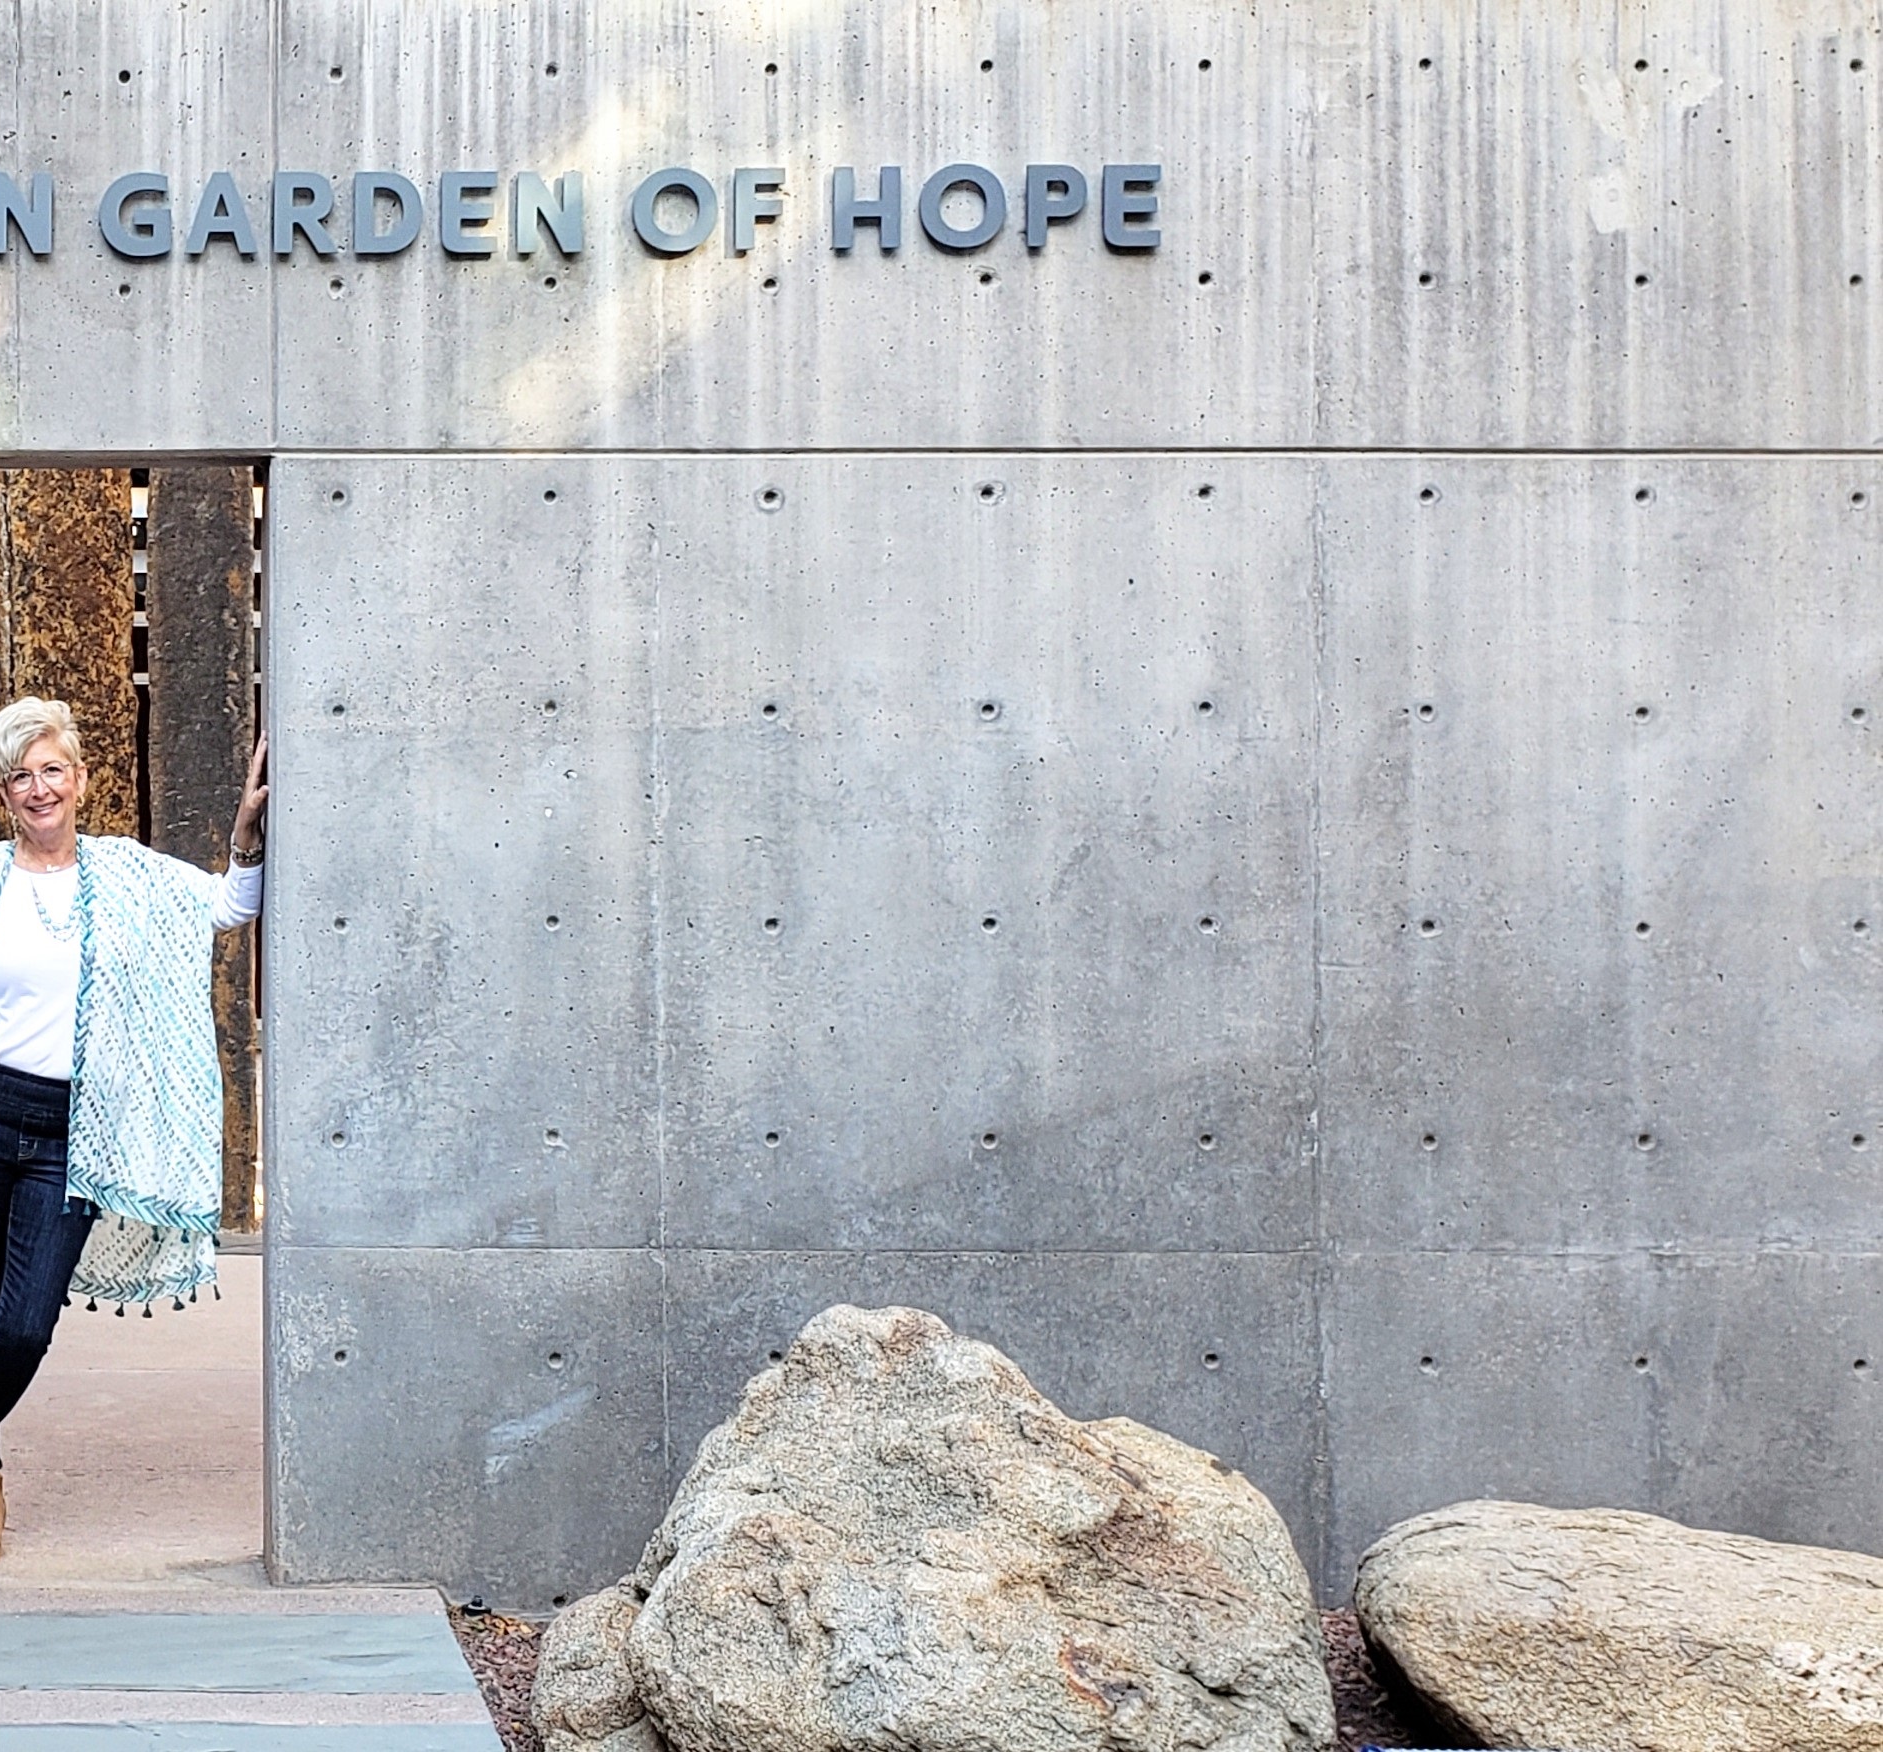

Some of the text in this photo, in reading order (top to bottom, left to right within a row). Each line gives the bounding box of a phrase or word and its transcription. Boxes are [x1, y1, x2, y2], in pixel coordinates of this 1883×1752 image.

[98, 170, 584, 257] GARDEN
[632, 166, 786, 253] OF
[831, 162, 1162, 249] HOPE
